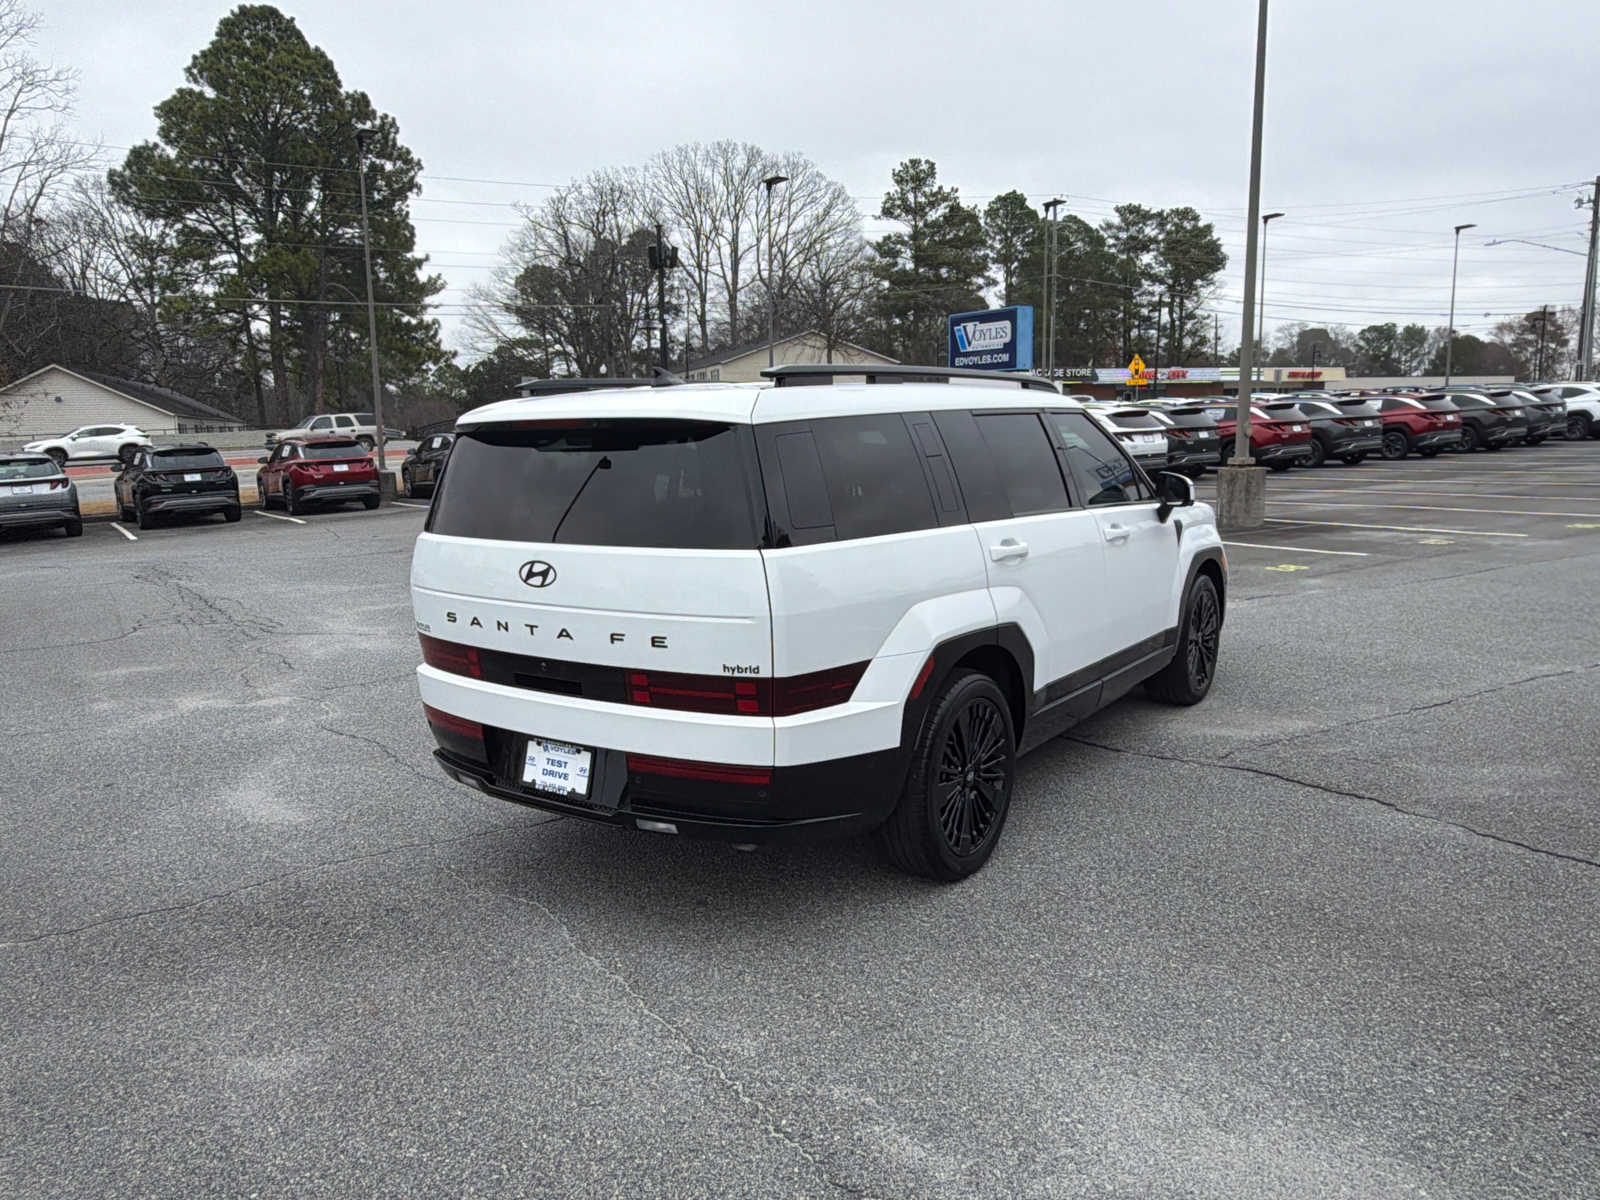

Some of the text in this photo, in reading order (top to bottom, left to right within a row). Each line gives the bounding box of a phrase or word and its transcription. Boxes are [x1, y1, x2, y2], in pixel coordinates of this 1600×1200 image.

[961, 324, 1008, 349] VOYLES
[971, 342, 1003, 350] AUTOMOTIVE
[954, 352, 1010, 367] EDVOYLES.COM
[1029, 368, 1092, 377] ACKGE STORE
[1168, 370, 1188, 380] CITY
[446, 611, 574, 641] SANTA
[609, 633, 669, 649] FE
[722, 663, 760, 675] hybrid
[546, 757, 569, 769] TEST
[542, 768, 570, 781] DRIVE
